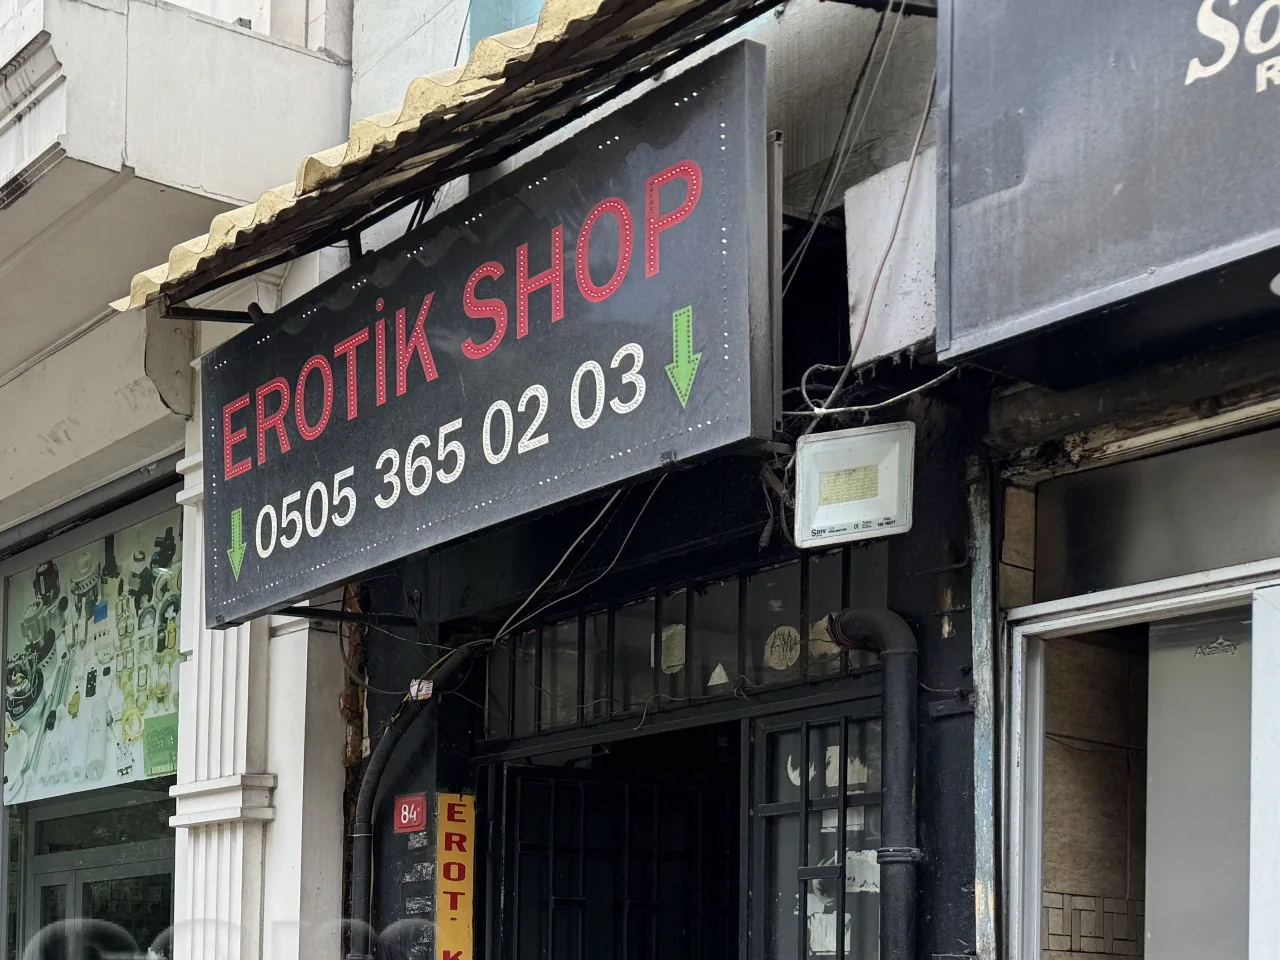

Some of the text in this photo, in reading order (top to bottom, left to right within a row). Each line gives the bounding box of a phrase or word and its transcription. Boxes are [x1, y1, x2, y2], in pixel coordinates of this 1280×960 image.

[461, 160, 703, 360] SHOP
[255, 342, 646, 559] 0505 365 02 03
[400, 804, 417, 824] 84
